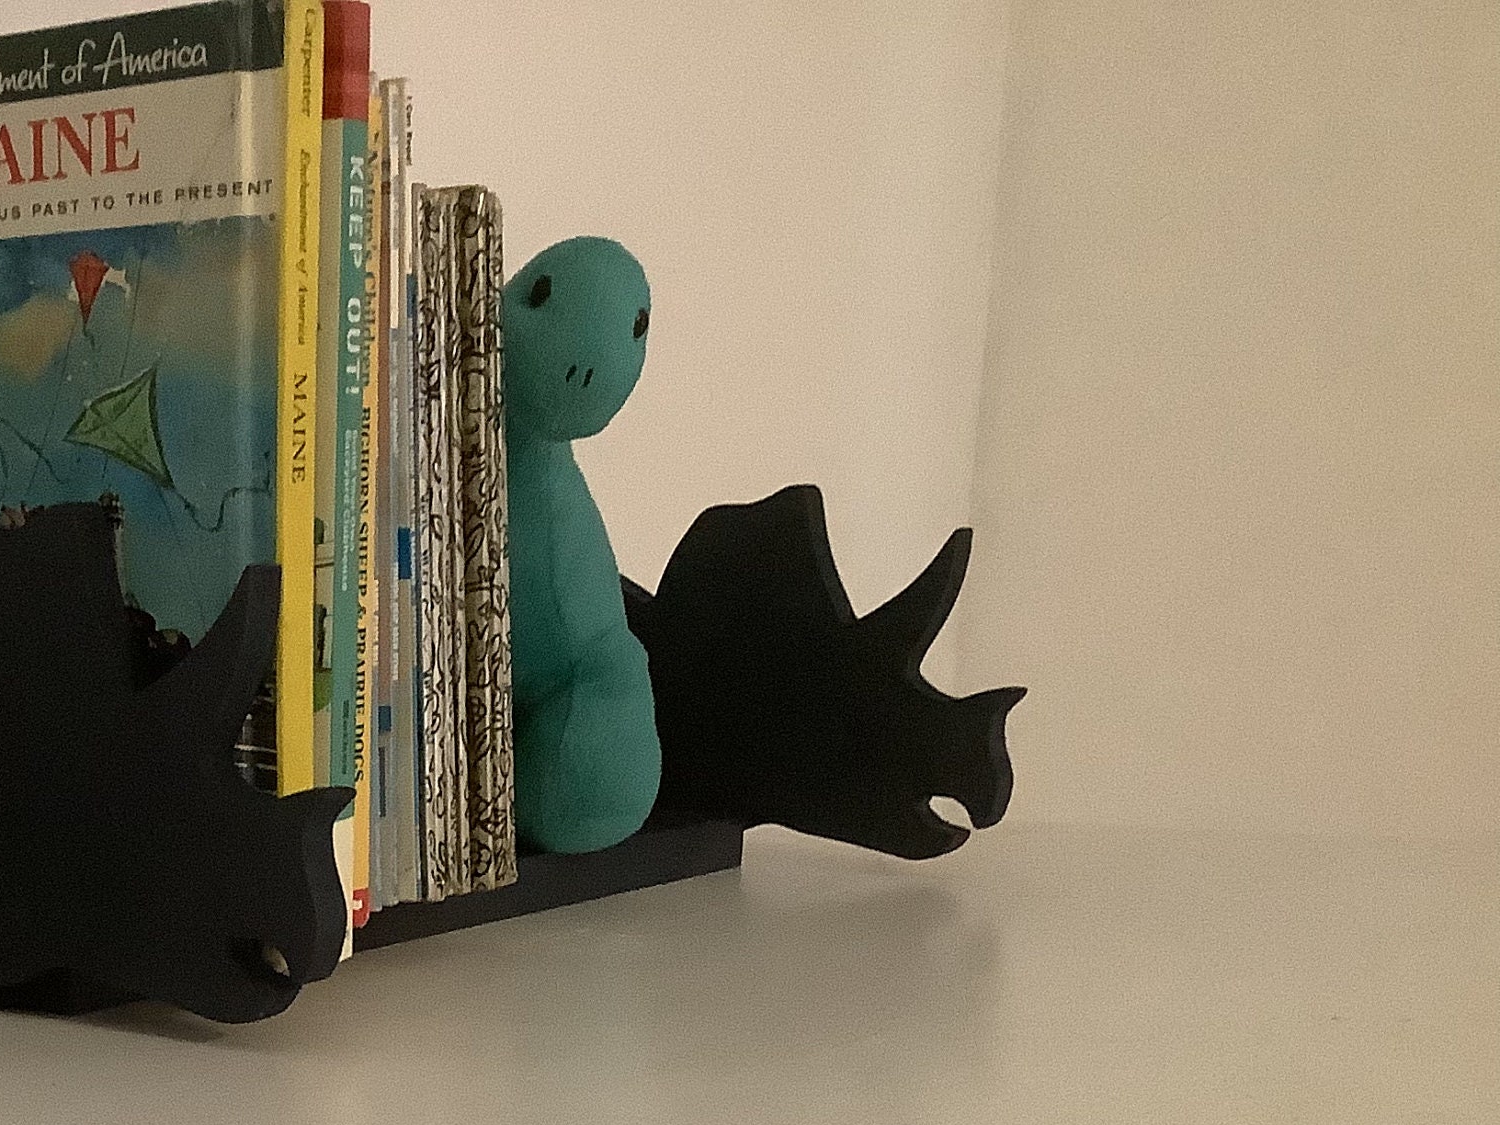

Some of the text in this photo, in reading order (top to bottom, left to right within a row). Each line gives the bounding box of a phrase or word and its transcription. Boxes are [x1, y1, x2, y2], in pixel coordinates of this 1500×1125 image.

[61, 39, 98, 88] of
[94, 32, 208, 83] America
[302, 7, 317, 118] Carpenter
[31, 199, 80, 217] PAST
[91, 195, 114, 212] TO
[126, 188, 163, 206] THE
[174, 179, 274, 201] PRESENT
[345, 156, 365, 395] KEEP OUT!
[291, 373, 308, 484] MAINE
